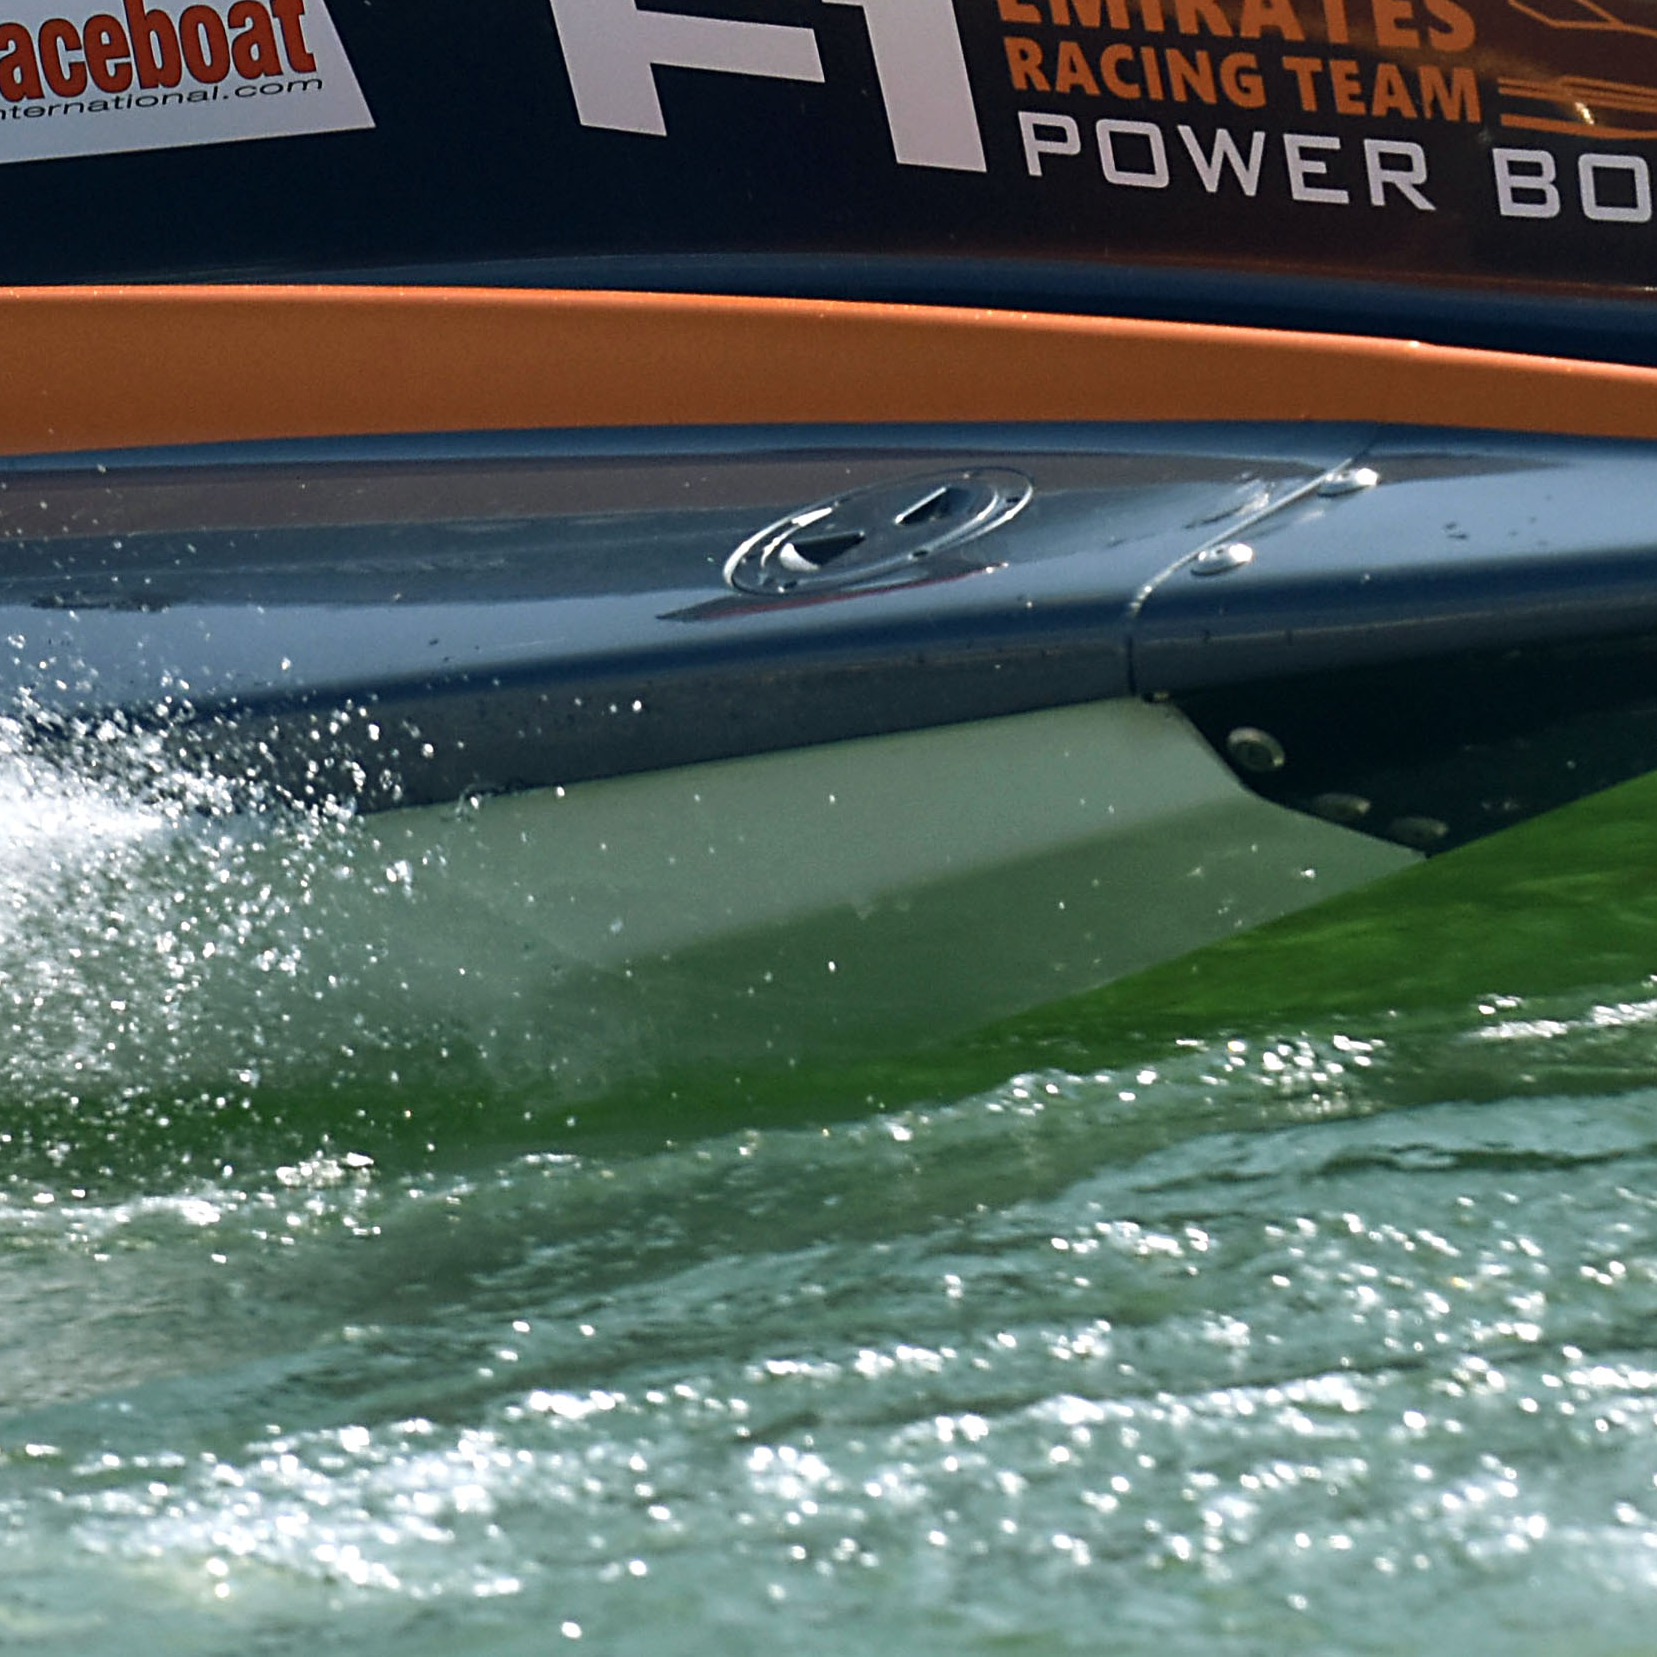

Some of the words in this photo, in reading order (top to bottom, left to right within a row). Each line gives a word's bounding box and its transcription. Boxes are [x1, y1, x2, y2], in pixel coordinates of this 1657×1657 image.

[1007, 41, 1268, 110] RACING
[1282, 55, 1481, 126] TEAM
[1017, 112, 1435, 211] POWER
